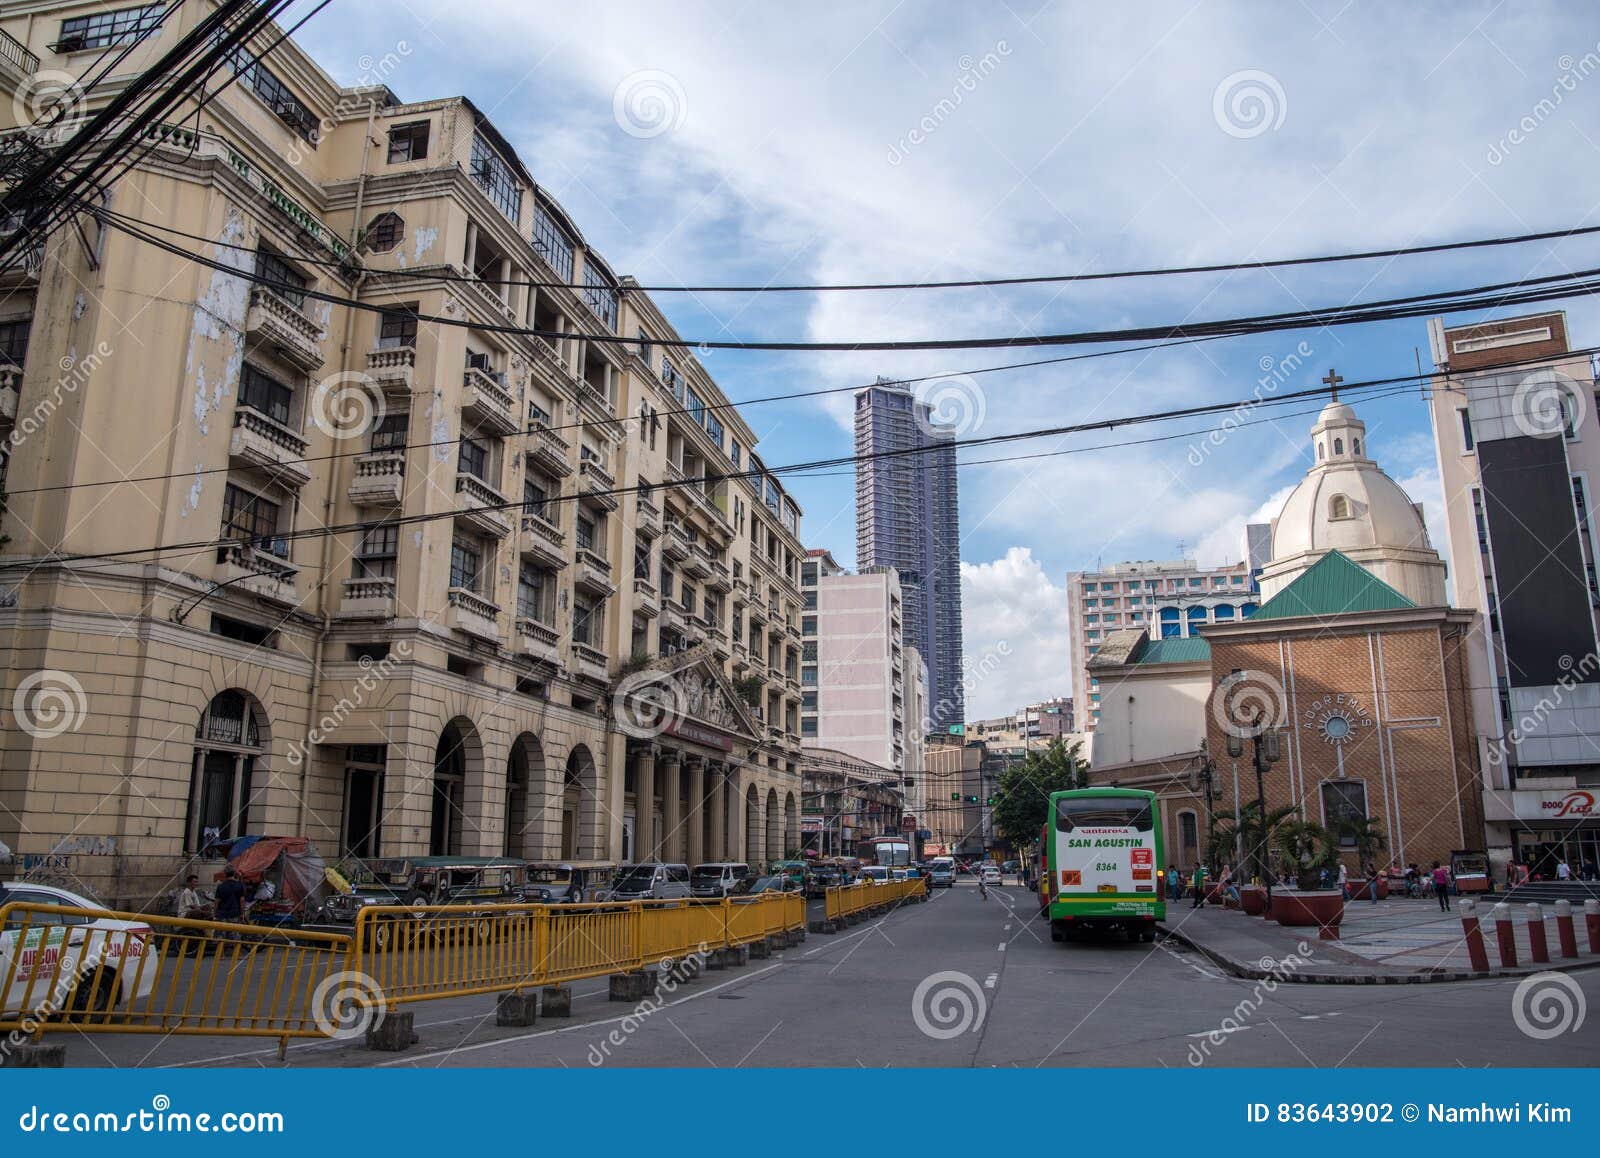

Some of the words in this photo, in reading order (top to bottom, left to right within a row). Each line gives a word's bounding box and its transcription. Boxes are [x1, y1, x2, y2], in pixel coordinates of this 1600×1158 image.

[1068, 838, 1091, 848] SAN
[1094, 838, 1143, 848] AGUSTIN
[1096, 863, 1117, 871] 8364
